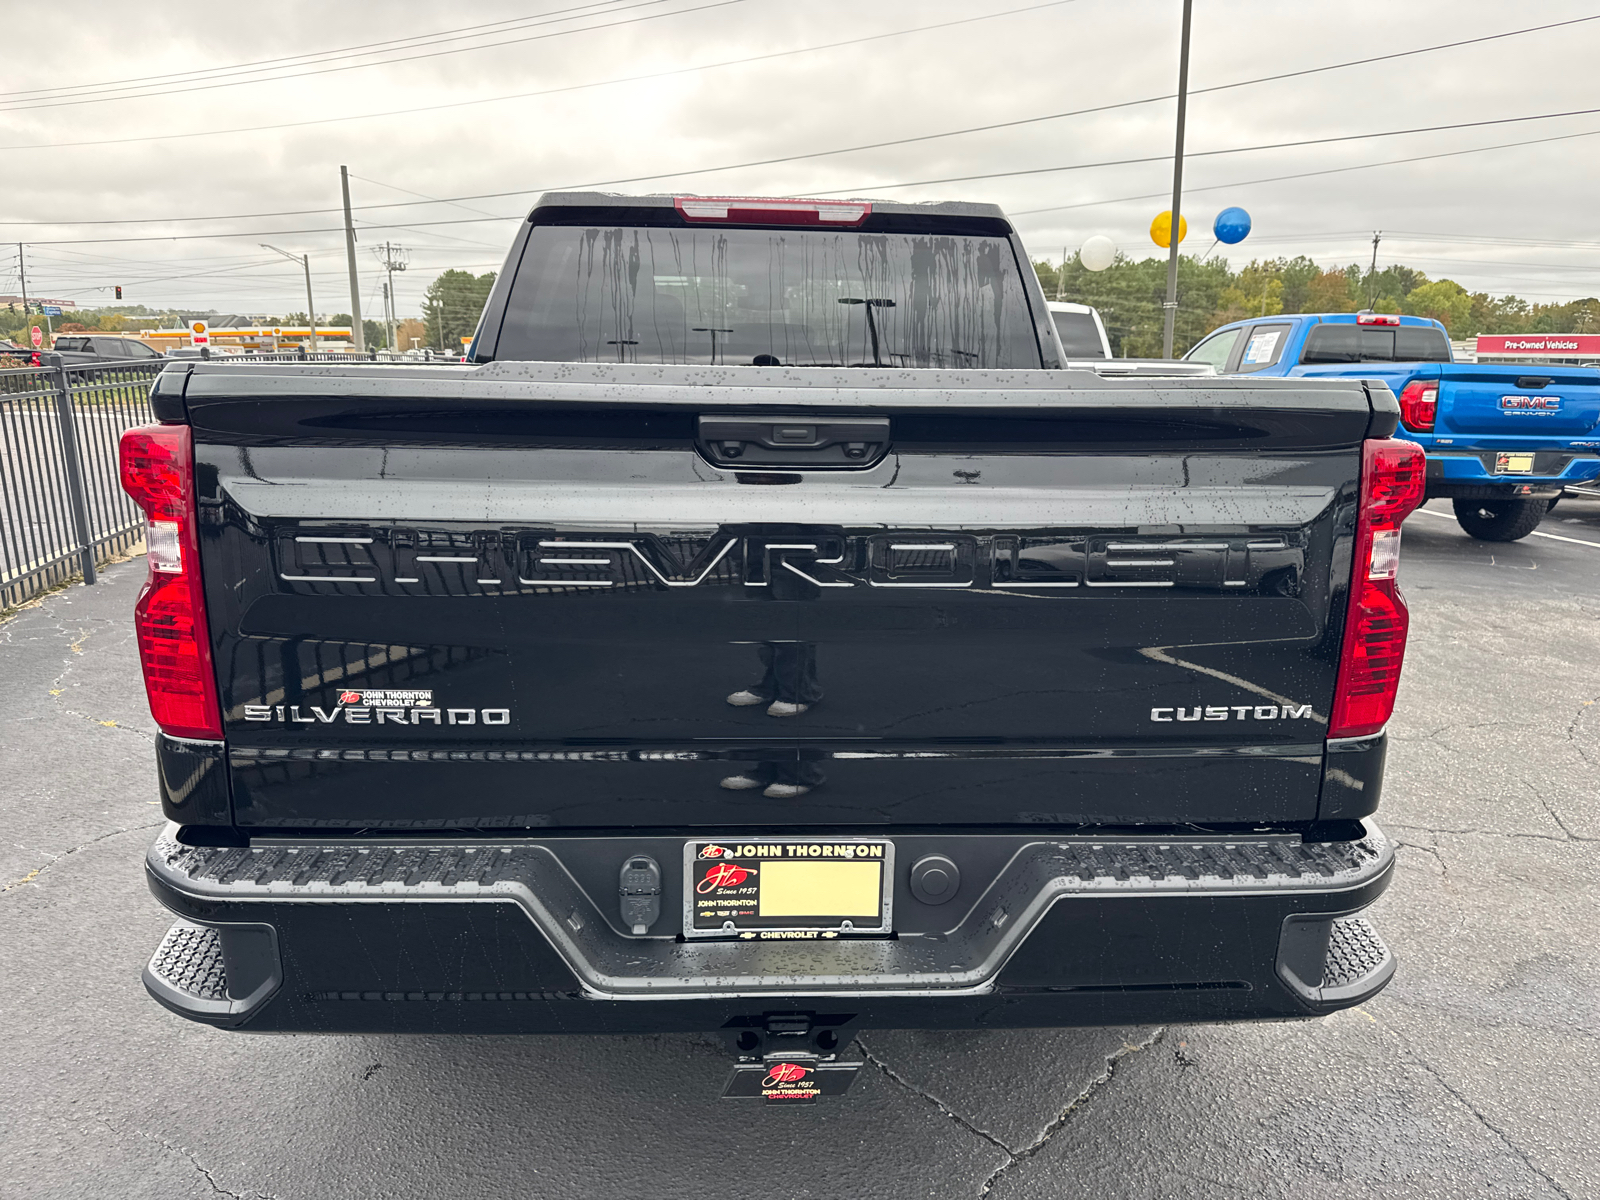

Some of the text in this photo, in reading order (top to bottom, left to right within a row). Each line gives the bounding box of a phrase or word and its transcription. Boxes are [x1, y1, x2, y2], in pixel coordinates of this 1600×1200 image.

[1505, 341, 1578, 349] Pre-Owned Vehicles
[1502, 396, 1560, 409] GMC
[277, 528, 1288, 588] CHEVROLET
[244, 705, 510, 725] SILVERADO
[1150, 705, 1312, 722] CUSTOM
[734, 845, 782, 857] JOHN
[787, 845, 882, 857] THORNTON
[760, 931, 818, 939] CHEVROLET
